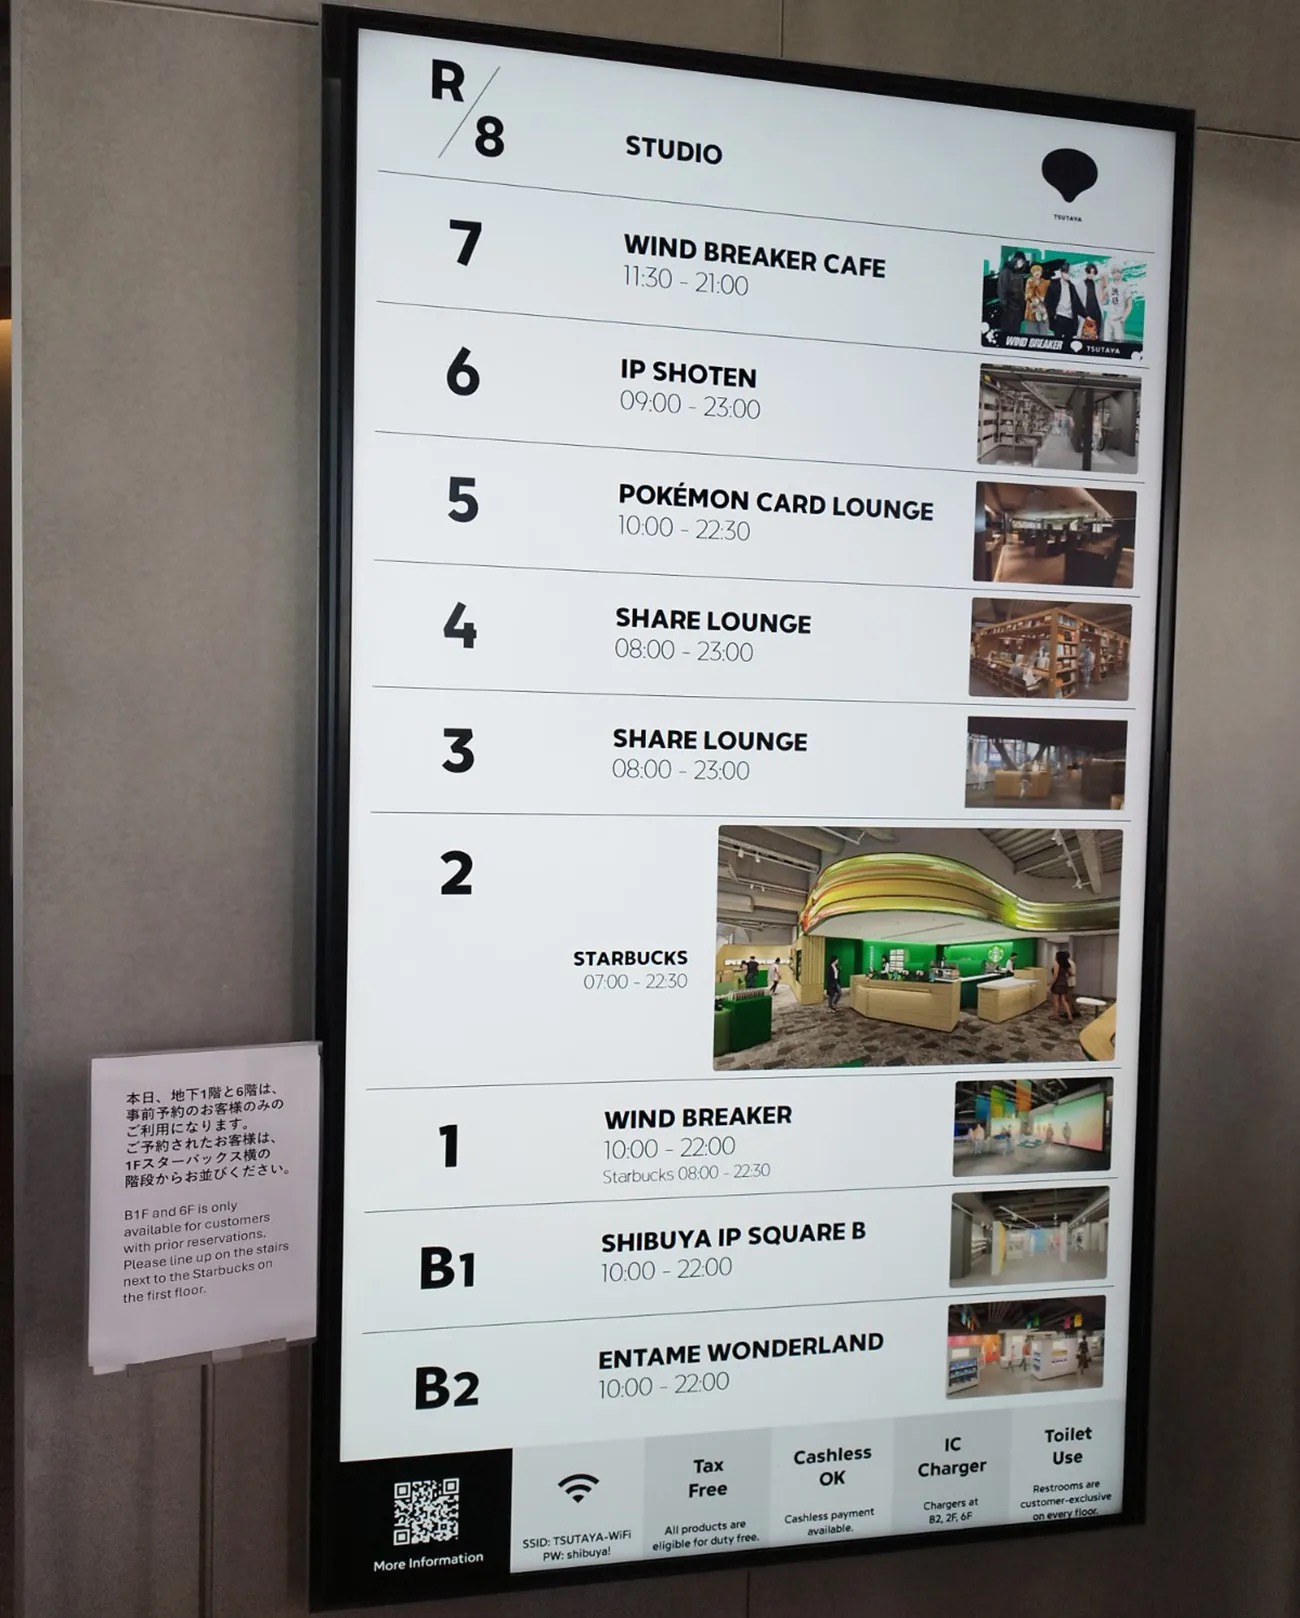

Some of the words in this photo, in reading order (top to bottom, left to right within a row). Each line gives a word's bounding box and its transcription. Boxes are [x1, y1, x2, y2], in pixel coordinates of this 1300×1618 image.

[432, 59, 465, 103] R
[475, 116, 505, 158] 8
[626, 135, 723, 165] STUDIO
[1054, 214, 1083, 223] TSUTAYA
[449, 220, 482, 267] 7
[624, 234, 697, 260] WIND
[704, 241, 817, 272] BREAKER
[824, 253, 886, 278] CAFE
[624, 265, 673, 289] 11:30
[695, 272, 749, 296] 21:00
[1029, 338, 1064, 351] BREAKER
[1086, 346, 1121, 354] TSUTAYA
[446, 346, 480, 396] 6
[621, 359, 646, 379] IP
[653, 361, 757, 388] SHOTEN
[620, 390, 682, 414] 09:00
[704, 396, 761, 420] 23:00
[448, 476, 479, 523] 5
[619, 482, 749, 510] POKÉMON
[756, 492, 826, 515] CARD
[833, 497, 934, 521] LOUNGE
[619, 514, 674, 538] 10:00
[696, 520, 751, 542] 22:30
[443, 601, 477, 649] 4
[616, 608, 701, 630] SHARE
[707, 612, 812, 634] LOUNGE
[615, 638, 675, 660] 08:00
[697, 641, 754, 662] 23:00
[442, 728, 475, 774] 3
[613, 729, 697, 750] SHARE
[704, 732, 808, 752] LOUNGE
[612, 758, 672, 779] 08:00
[695, 760, 750, 781] 23:00
[440, 850, 473, 895] 2
[573, 950, 688, 967] STARBUCKS
[584, 974, 629, 989] 07:00
[646, 973, 688, 988] 22:30
[126, 1083, 278, 1105] 本日、地下1階と6階は、
[126, 1099, 284, 1121] 事前予約のお客様のみの
[605, 1110, 675, 1130] WIND
[683, 1105, 792, 1127] BREAKER
[127, 1120, 250, 1138] ご利用になります。
[126, 1131, 277, 1155] ご予約されたお客様は、
[439, 1125, 458, 1168] 1
[604, 1139, 658, 1160] 10:00
[680, 1136, 736, 1157] 22:00
[125, 1149, 271, 1171] 1Fスターバックス横の
[125, 1164, 290, 1189] 階段からお並びください。
[603, 1166, 675, 1184] Starbucks
[678, 1165, 719, 1180] 08:00
[734, 1163, 771, 1178] 22:30
[125, 1209, 149, 1221] B1F
[152, 1207, 176, 1219] and
[179, 1205, 195, 1216] 6F
[198, 1205, 208, 1214] is
[211, 1201, 238, 1216] only
[124, 1223, 181, 1237] available
[185, 1220, 201, 1232] for
[205, 1212, 270, 1230] customers
[124, 1242, 151, 1254] with
[154, 1240, 184, 1255] prior
[187, 1230, 266, 1248] reservations.
[602, 1229, 712, 1253] SHIBUYA
[719, 1227, 742, 1247] IP
[748, 1223, 845, 1245] SQUARE
[853, 1222, 866, 1239] B
[124, 1257, 167, 1271] Please
[170, 1254, 193, 1266] line
[196, 1252, 212, 1265] up
[215, 1250, 231, 1260] on
[234, 1246, 253, 1258] the
[256, 1241, 289, 1254] stairs
[123, 1274, 151, 1287] next
[154, 1273, 166, 1284] to
[169, 1269, 190, 1282] the
[193, 1263, 254, 1279] Starbucks
[258, 1259, 273, 1269] on
[420, 1246, 475, 1290] B1
[602, 1261, 655, 1283] 10:00
[677, 1257, 733, 1279] 22:00
[123, 1291, 144, 1304] the
[147, 1287, 172, 1301] first
[175, 1285, 207, 1297] floor.
[599, 1345, 701, 1369] ENTAME
[708, 1332, 884, 1363] WONDERLAND
[415, 1367, 479, 1411] B2
[599, 1377, 653, 1399] 10:00
[675, 1372, 730, 1394] 22:00
[944, 1437, 962, 1452] IC
[1045, 1427, 1093, 1443] Toilet
[694, 1460, 724, 1474] Tax
[794, 1446, 872, 1465] Cashless
[1052, 1451, 1083, 1465] Use
[819, 1471, 846, 1487] OK
[917, 1460, 987, 1478] Charger
[689, 1483, 728, 1498] Free
[1033, 1482, 1084, 1494] Restrooms
[1087, 1481, 1100, 1490] are
[923, 1499, 964, 1512] Chargers
[967, 1498, 979, 1507] at
[1020, 1492, 1112, 1509] customer-exclusive
[785, 1512, 829, 1525] Cashless
[831, 1508, 875, 1522] payment
[929, 1514, 944, 1525] B2,
[947, 1512, 959, 1524] 2F,
[961, 1511, 972, 1521] 6F
[1033, 1513, 1045, 1521] on
[1047, 1510, 1072, 1522] every
[1074, 1507, 1099, 1518] floor.
[523, 1537, 551, 1550] SSID:
[553, 1528, 632, 1547] TSUTAYA-WiFi
[665, 1526, 678, 1536] All
[682, 1523, 728, 1535] products
[730, 1521, 746, 1529] are
[807, 1524, 854, 1537] available.
[543, 1551, 564, 1562] PW:
[567, 1546, 611, 1561] shibuya!
[653, 1537, 691, 1552] eligible
[694, 1538, 707, 1547] for
[711, 1536, 735, 1547] duty
[737, 1533, 759, 1543] free.
[374, 1559, 406, 1572] More
[409, 1552, 484, 1569] Information
